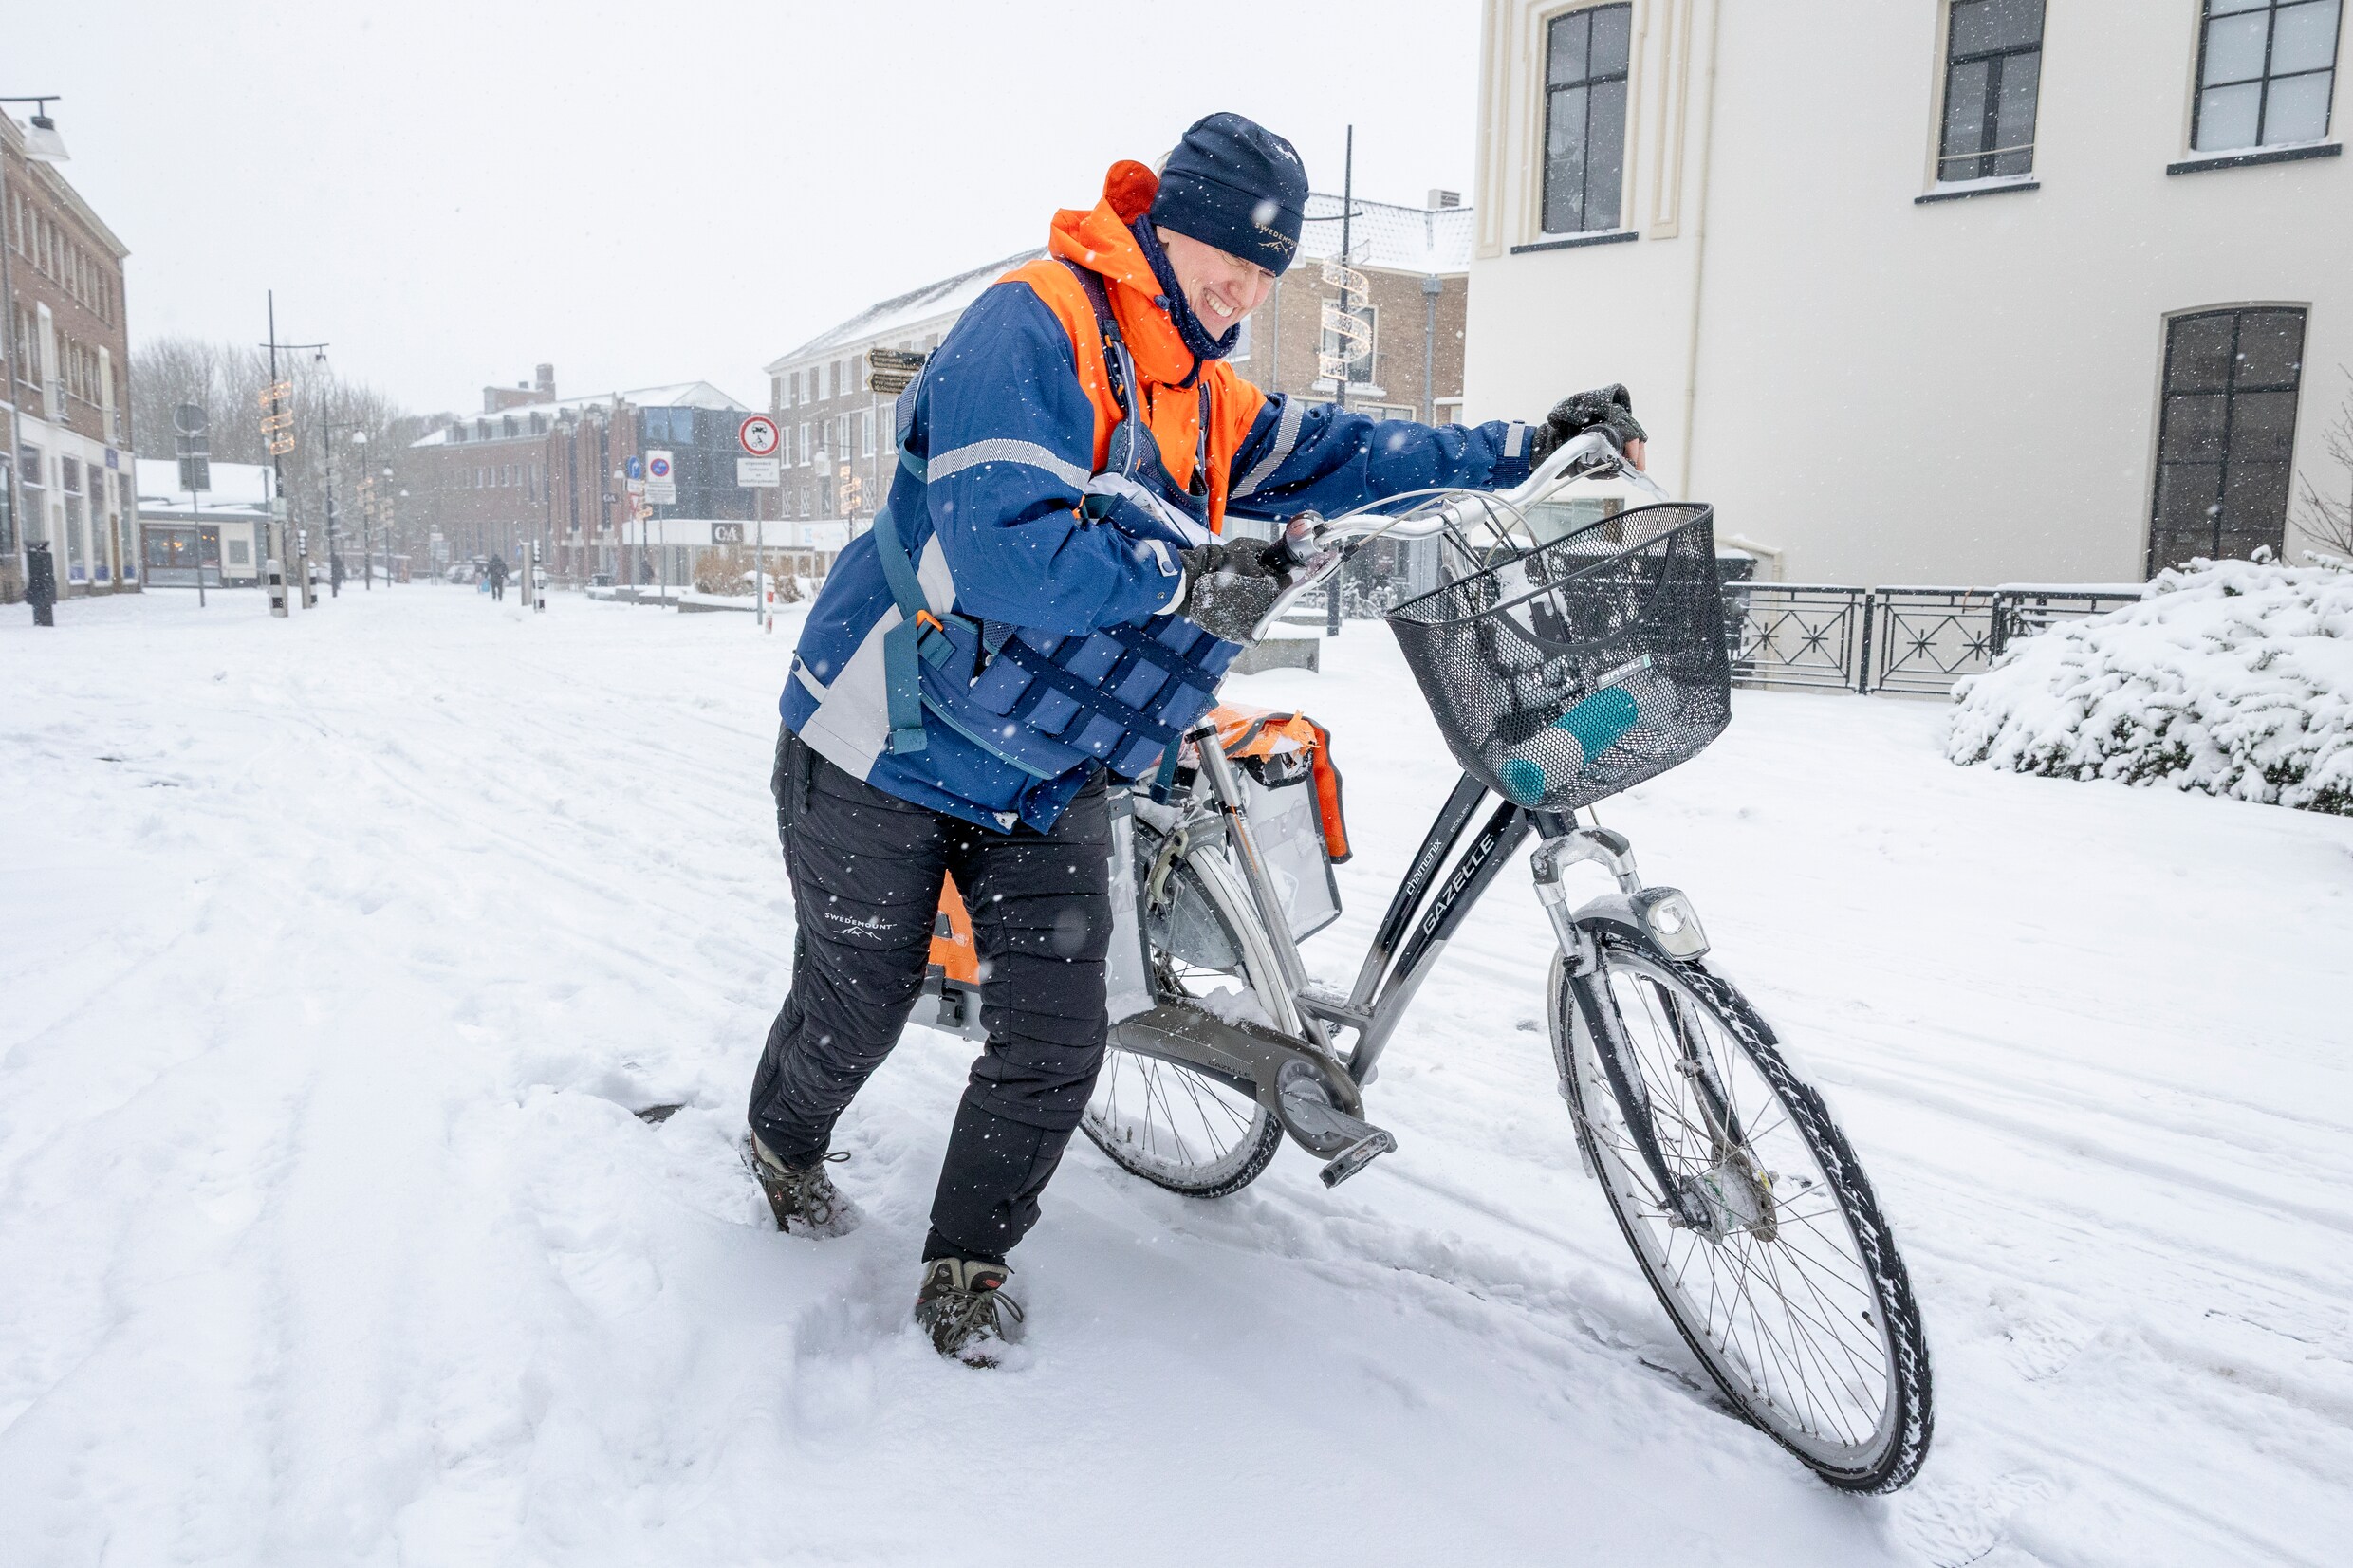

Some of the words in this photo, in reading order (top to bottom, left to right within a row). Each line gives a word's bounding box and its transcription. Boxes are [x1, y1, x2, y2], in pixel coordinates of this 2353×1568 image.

[1601, 661, 1641, 683] BASIL
[1450, 802, 1471, 833] EXCELLENT
[1406, 838, 1442, 895] chamonix
[1423, 833, 1495, 935] GAZELLE
[824, 912, 893, 930] SWEDEMOUNT
